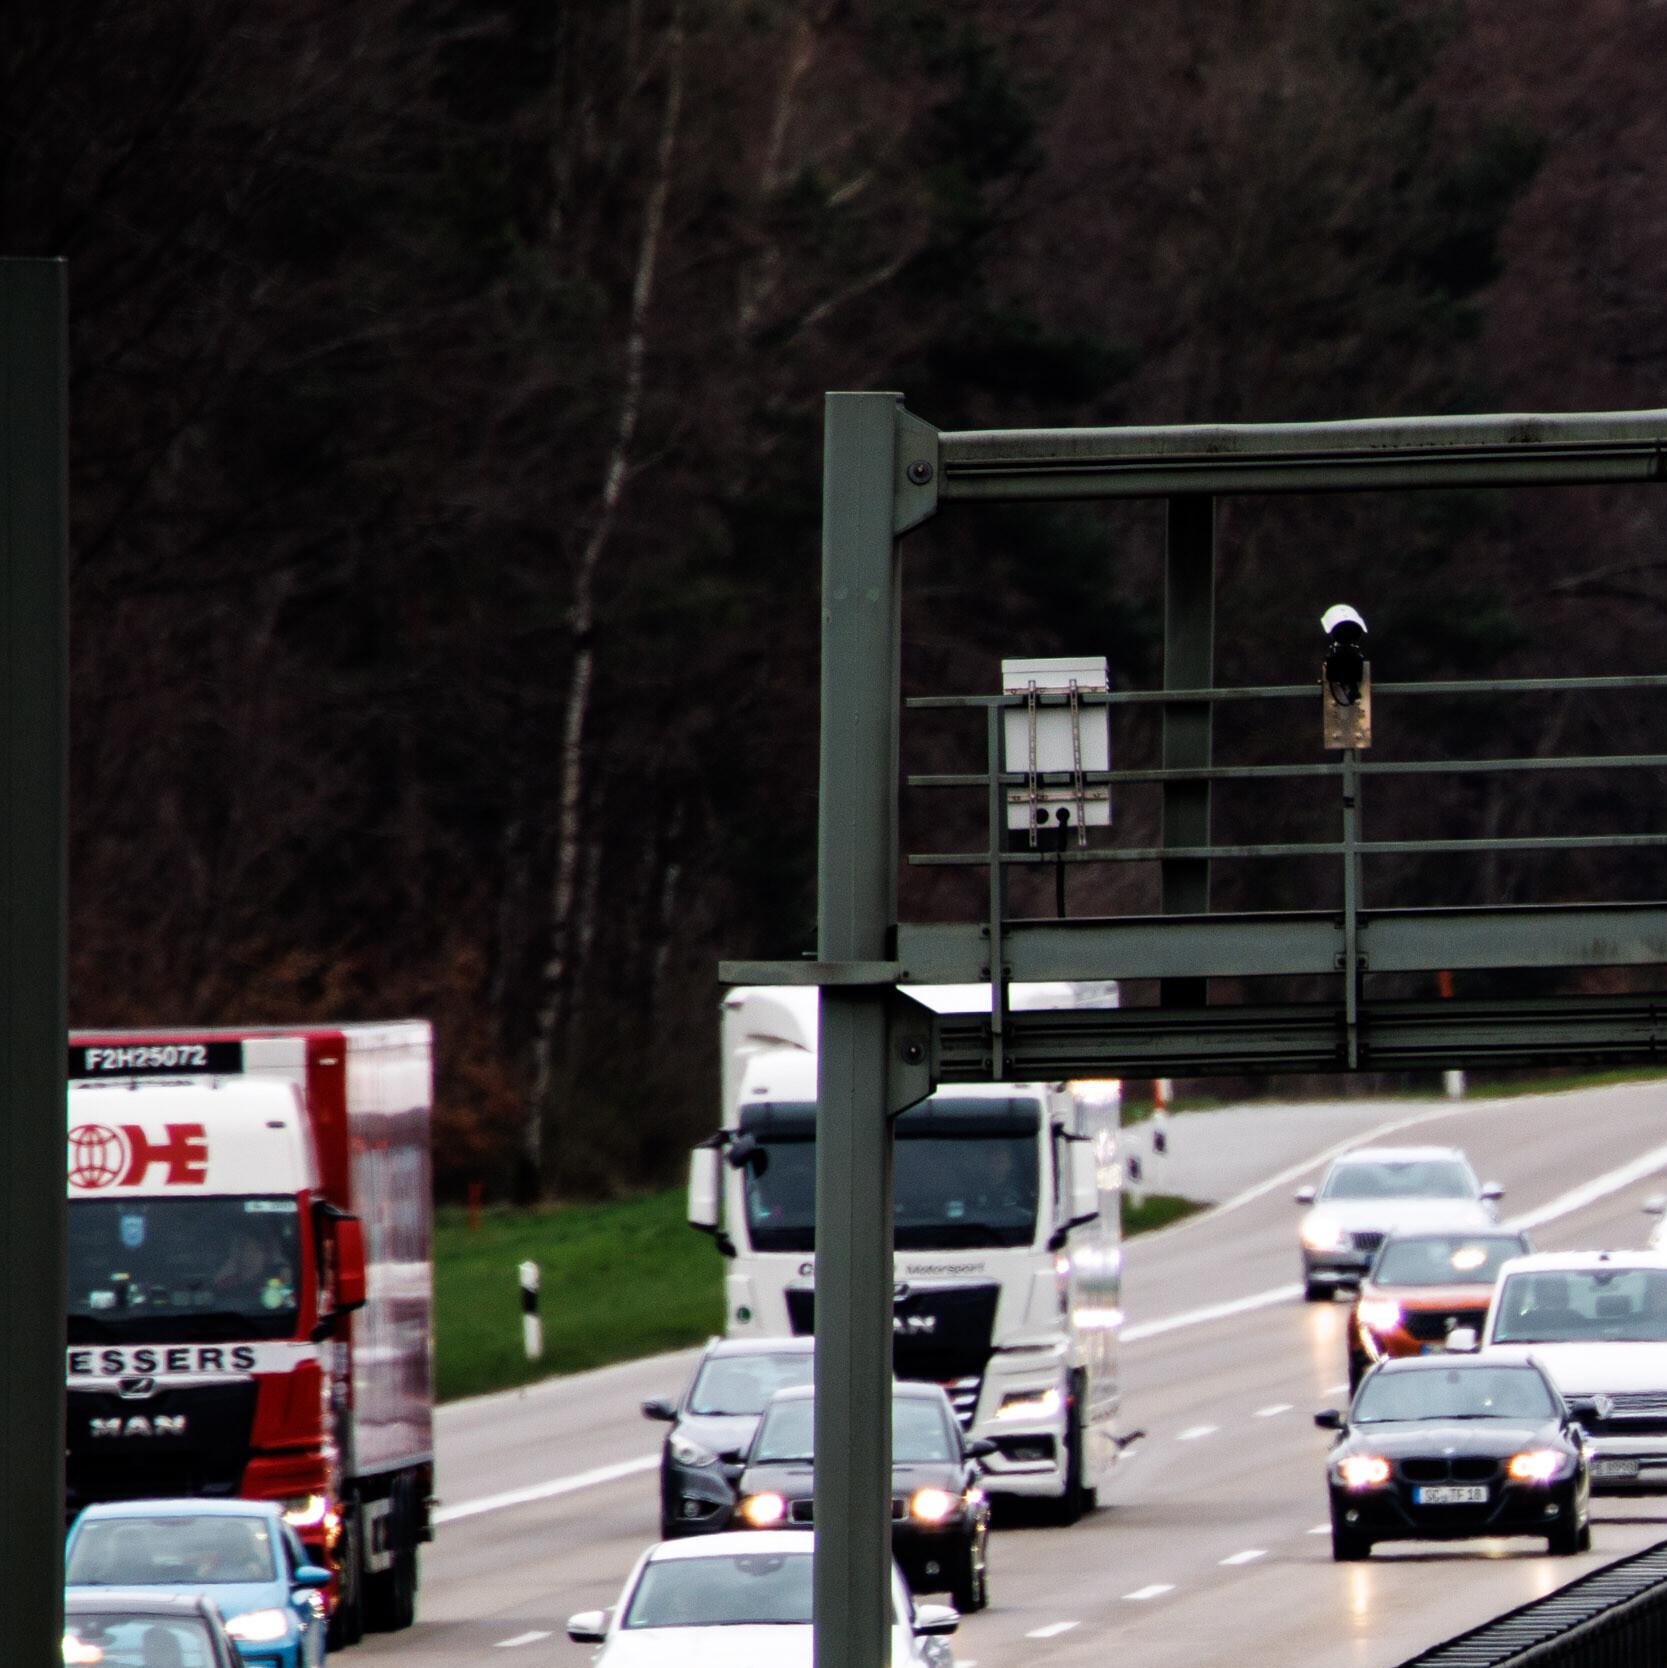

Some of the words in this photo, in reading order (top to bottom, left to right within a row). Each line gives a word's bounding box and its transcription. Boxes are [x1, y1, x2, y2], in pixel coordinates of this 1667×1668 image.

[85, 1045, 208, 1070] F2H25072
[69, 1346, 256, 1374] ESSERS
[89, 1413, 187, 1438] MAN
